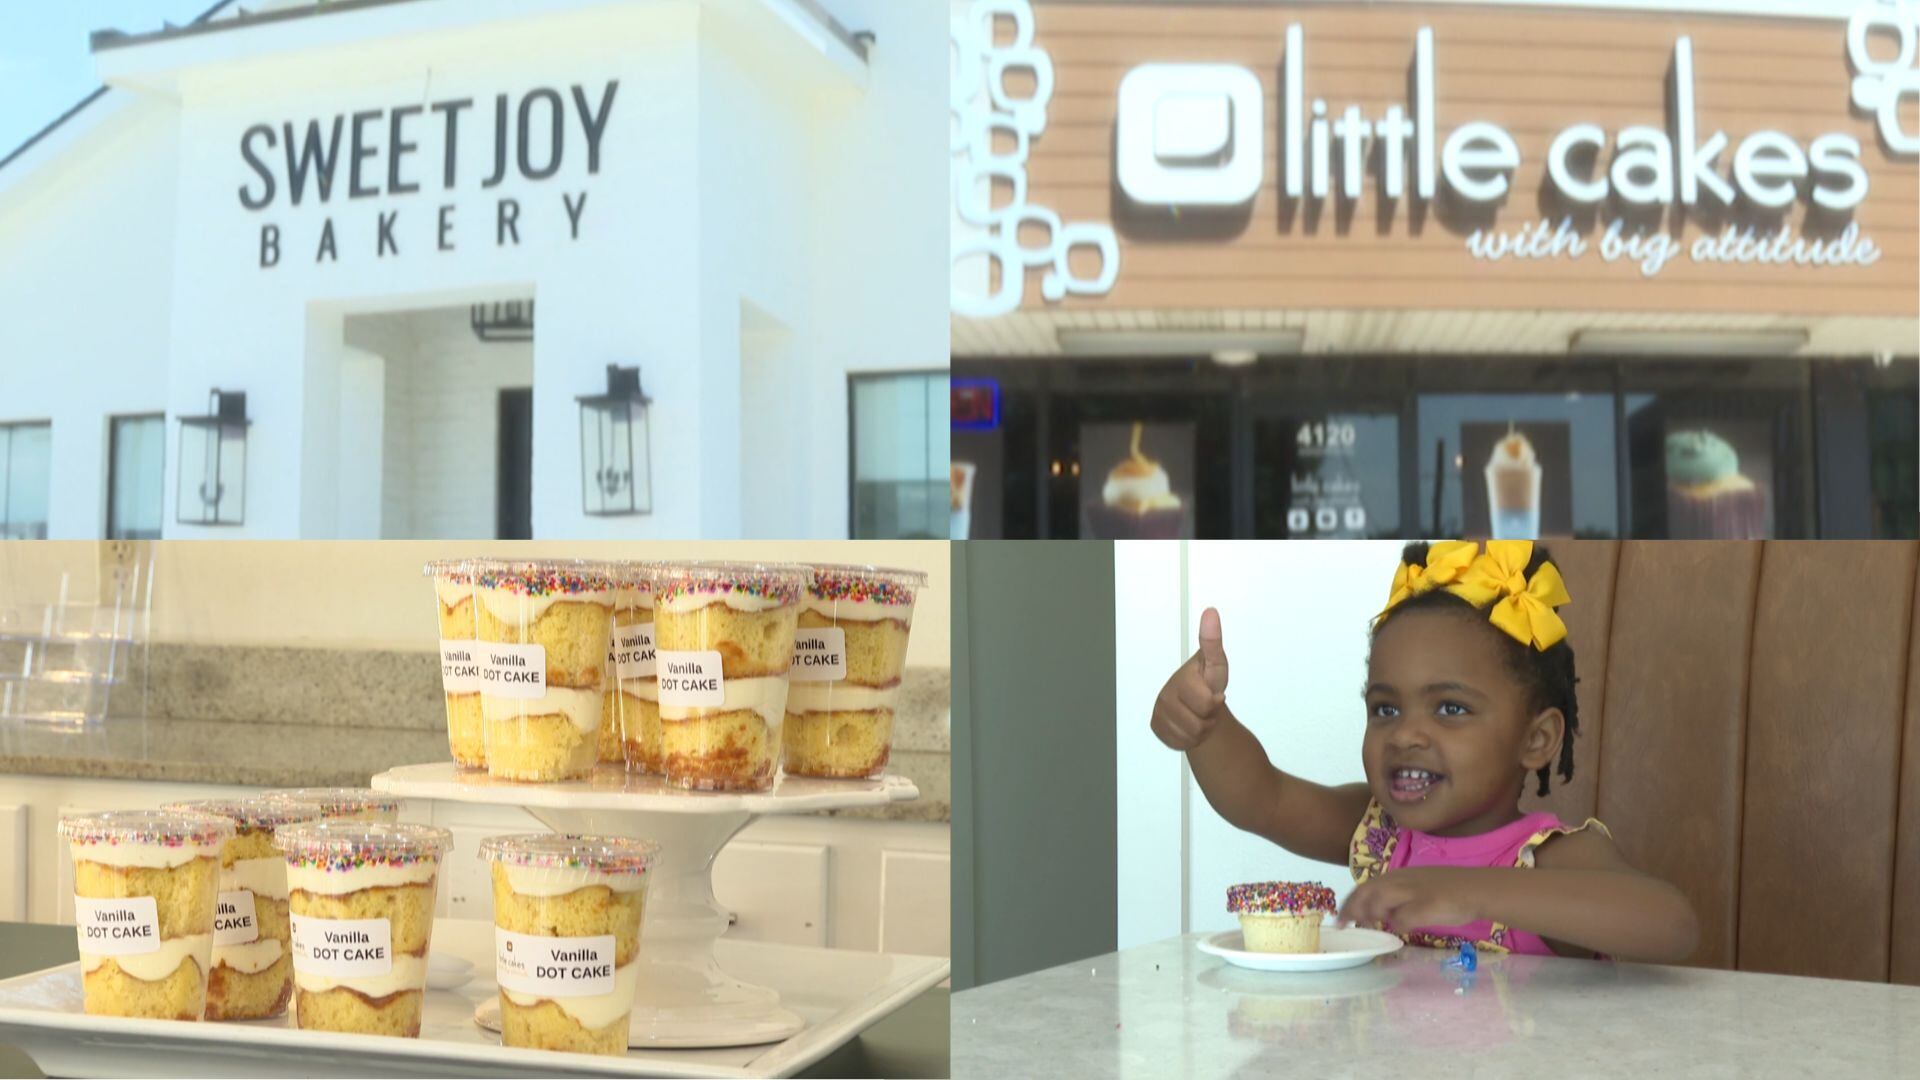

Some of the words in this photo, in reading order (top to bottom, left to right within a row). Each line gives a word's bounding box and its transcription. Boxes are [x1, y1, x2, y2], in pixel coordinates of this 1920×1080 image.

[1285, 22, 1521, 200] little
[1547, 34, 1870, 209] cakes
[238, 97, 474, 212] SWEET
[481, 79, 620, 190] JOY
[259, 191, 588, 269] BAKERY
[1465, 214, 1588, 261] with
[1600, 217, 1681, 277] big
[1690, 218, 1882, 266] attitude
[1296, 421, 1356, 447] 4120
[620, 633, 651, 649] Vanilla
[490, 653, 527, 667] Vanilla
[803, 654, 840, 667] CAKE
[483, 667, 502, 682] DOT
[504, 670, 541, 684] CAKE
[667, 661, 703, 675] Vanilla
[661, 678, 679, 691] DOT
[681, 678, 719, 692] CAKE
[94, 909, 136, 922] Vanilla
[214, 915, 252, 931] CAKE
[87, 926, 109, 939] DOT
[112, 924, 153, 939] CAKE
[324, 930, 370, 944] Vanilla
[313, 947, 340, 960] DOT
[343, 946, 385, 961] CAKE
[551, 948, 599, 962] Vanilla
[536, 966, 567, 979] DOT
[571, 964, 612, 980] CAKE
